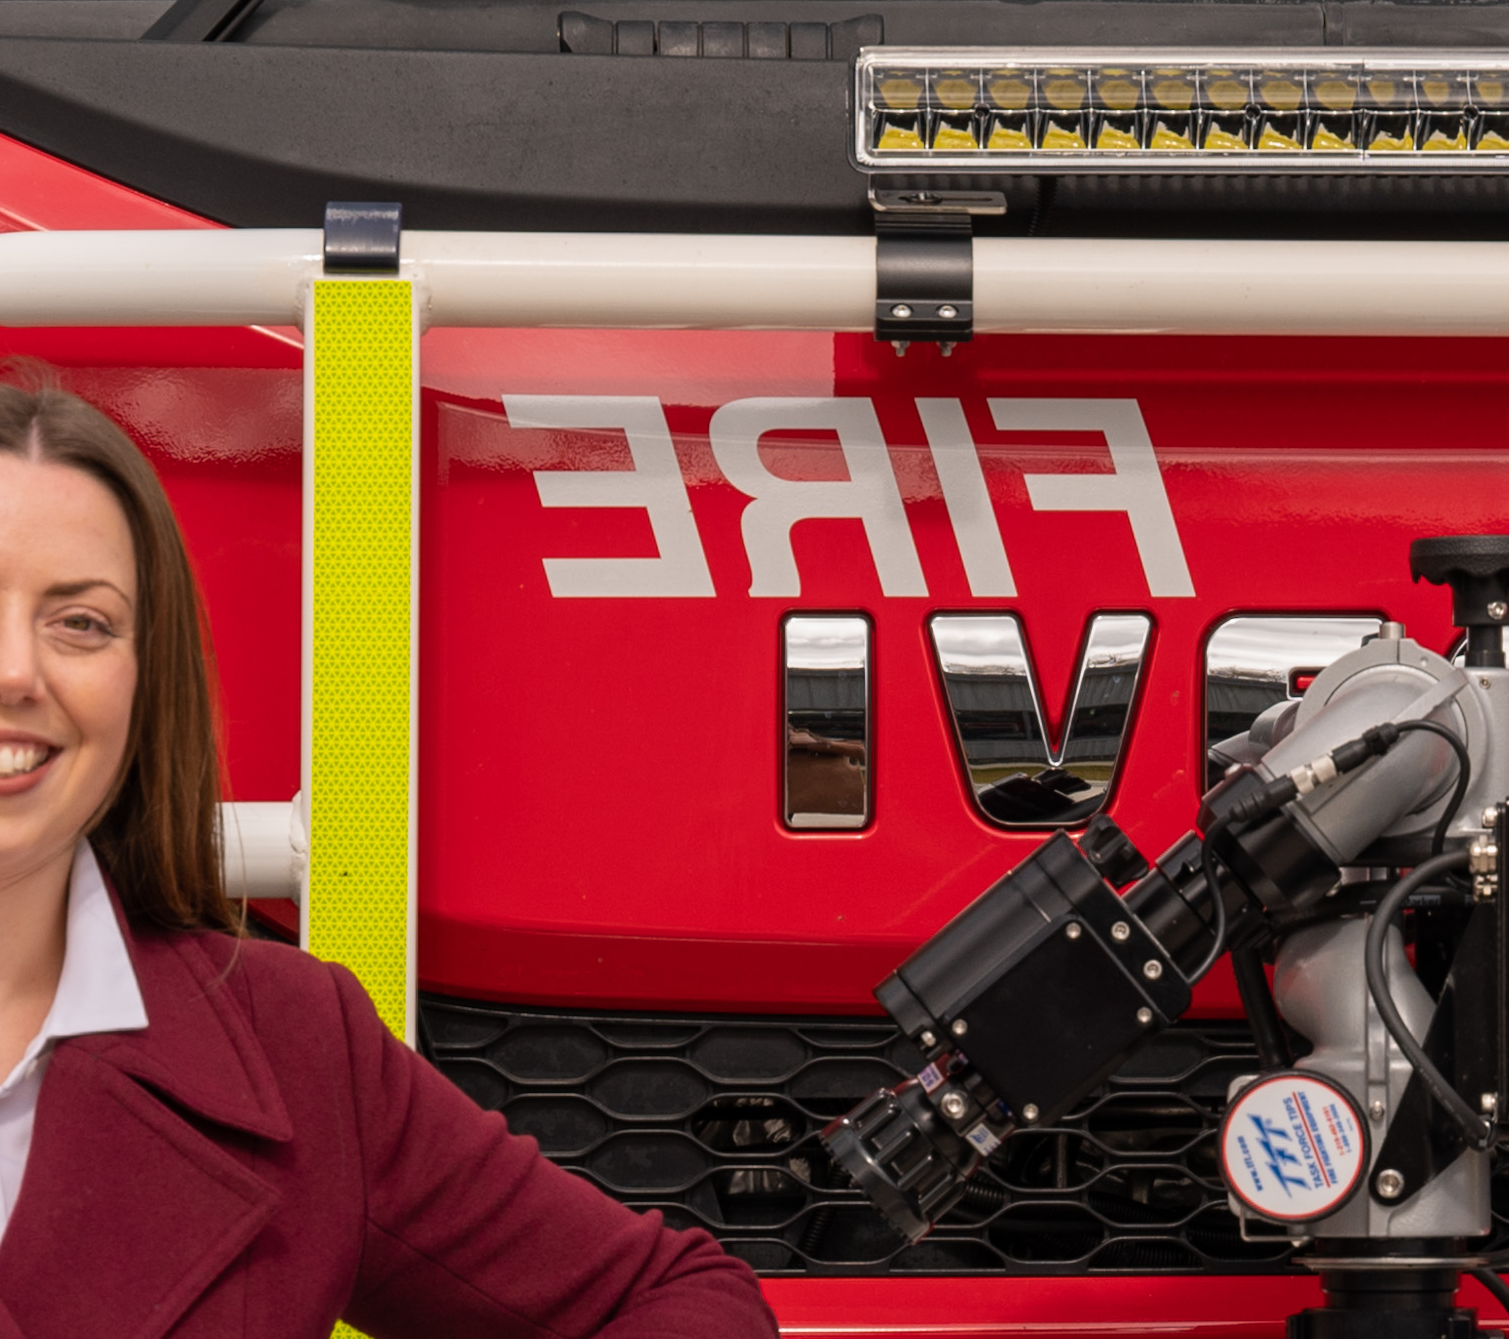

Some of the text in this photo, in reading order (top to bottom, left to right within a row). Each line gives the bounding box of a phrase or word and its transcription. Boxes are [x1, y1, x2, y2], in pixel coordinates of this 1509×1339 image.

[1247, 1114, 1311, 1198] TFT
[1283, 1097, 1323, 1187] TASK FORCE TIPS
[1298, 1092, 1338, 1184] FIRE FIGHTING EQUIPMENT
